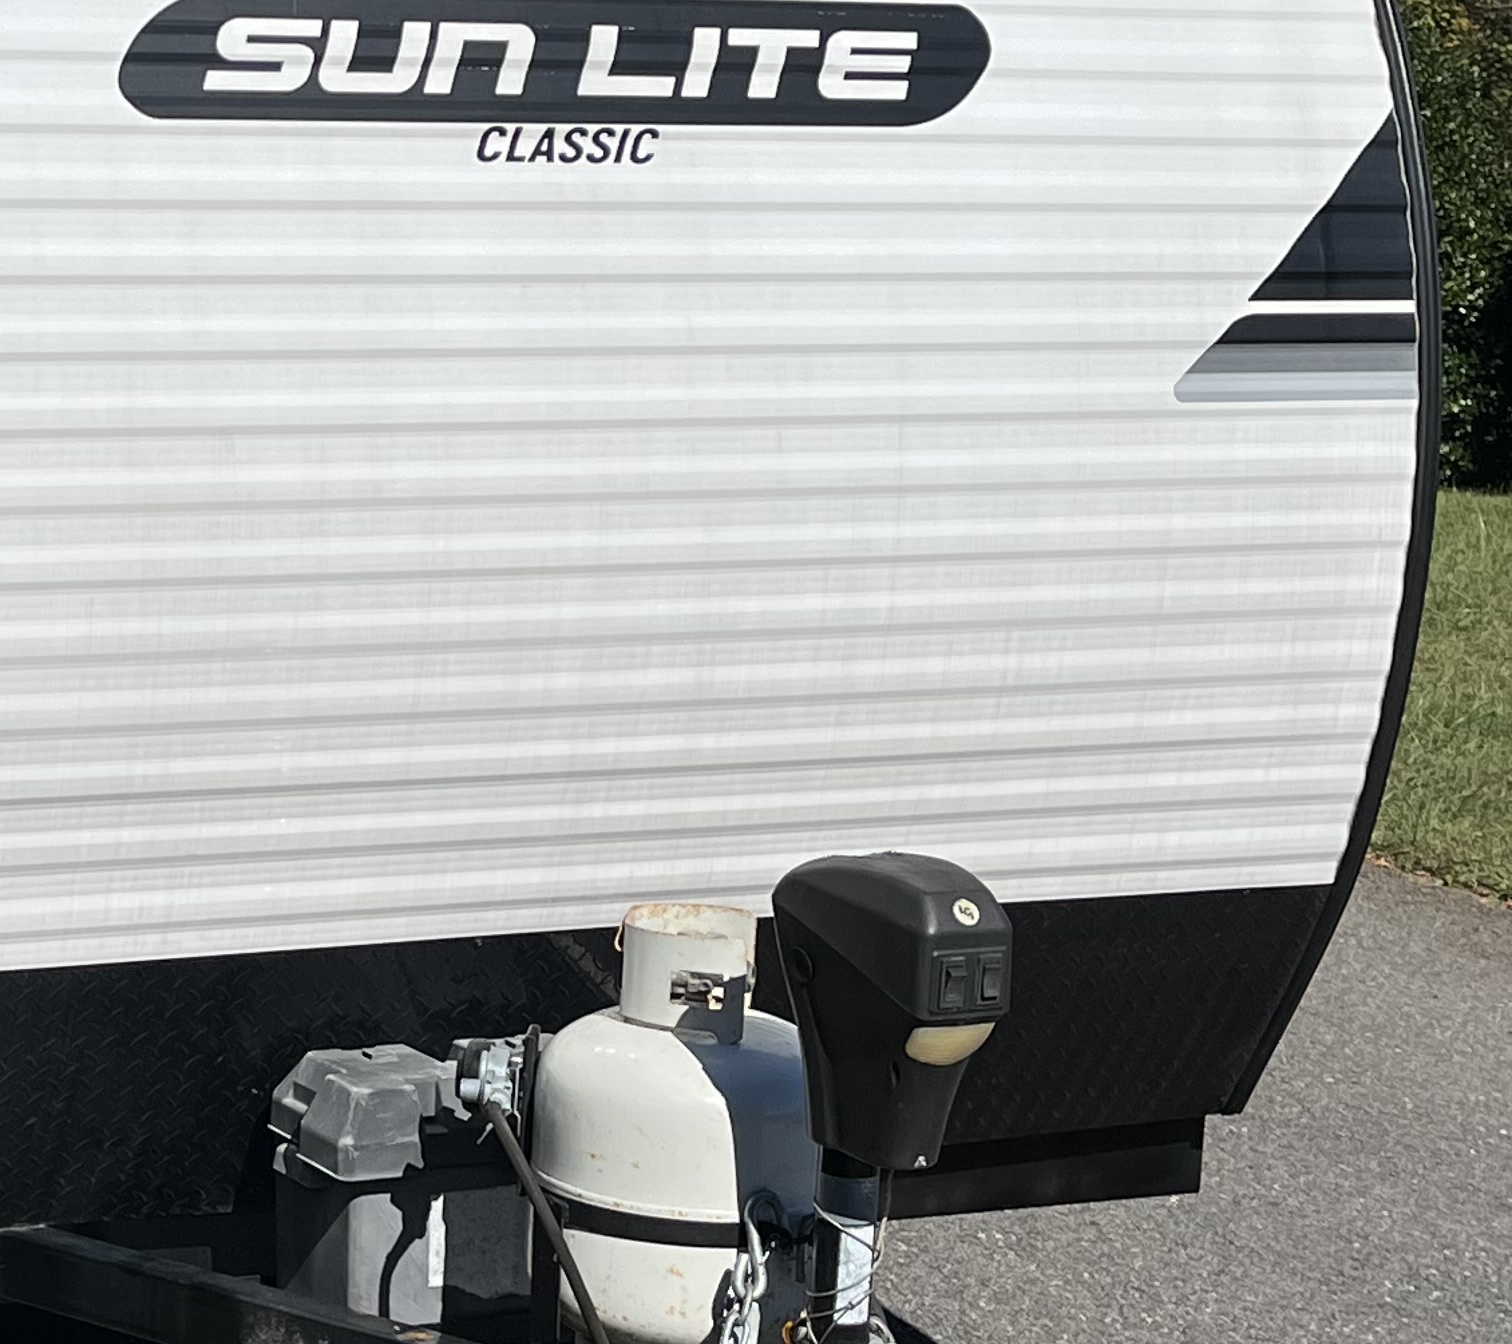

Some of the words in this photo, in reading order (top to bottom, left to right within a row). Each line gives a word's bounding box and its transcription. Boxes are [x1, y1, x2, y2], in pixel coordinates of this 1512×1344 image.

[202, 17, 536, 96] SUN
[576, 24, 919, 101] LITE
[476, 125, 660, 165] CLASSIC
